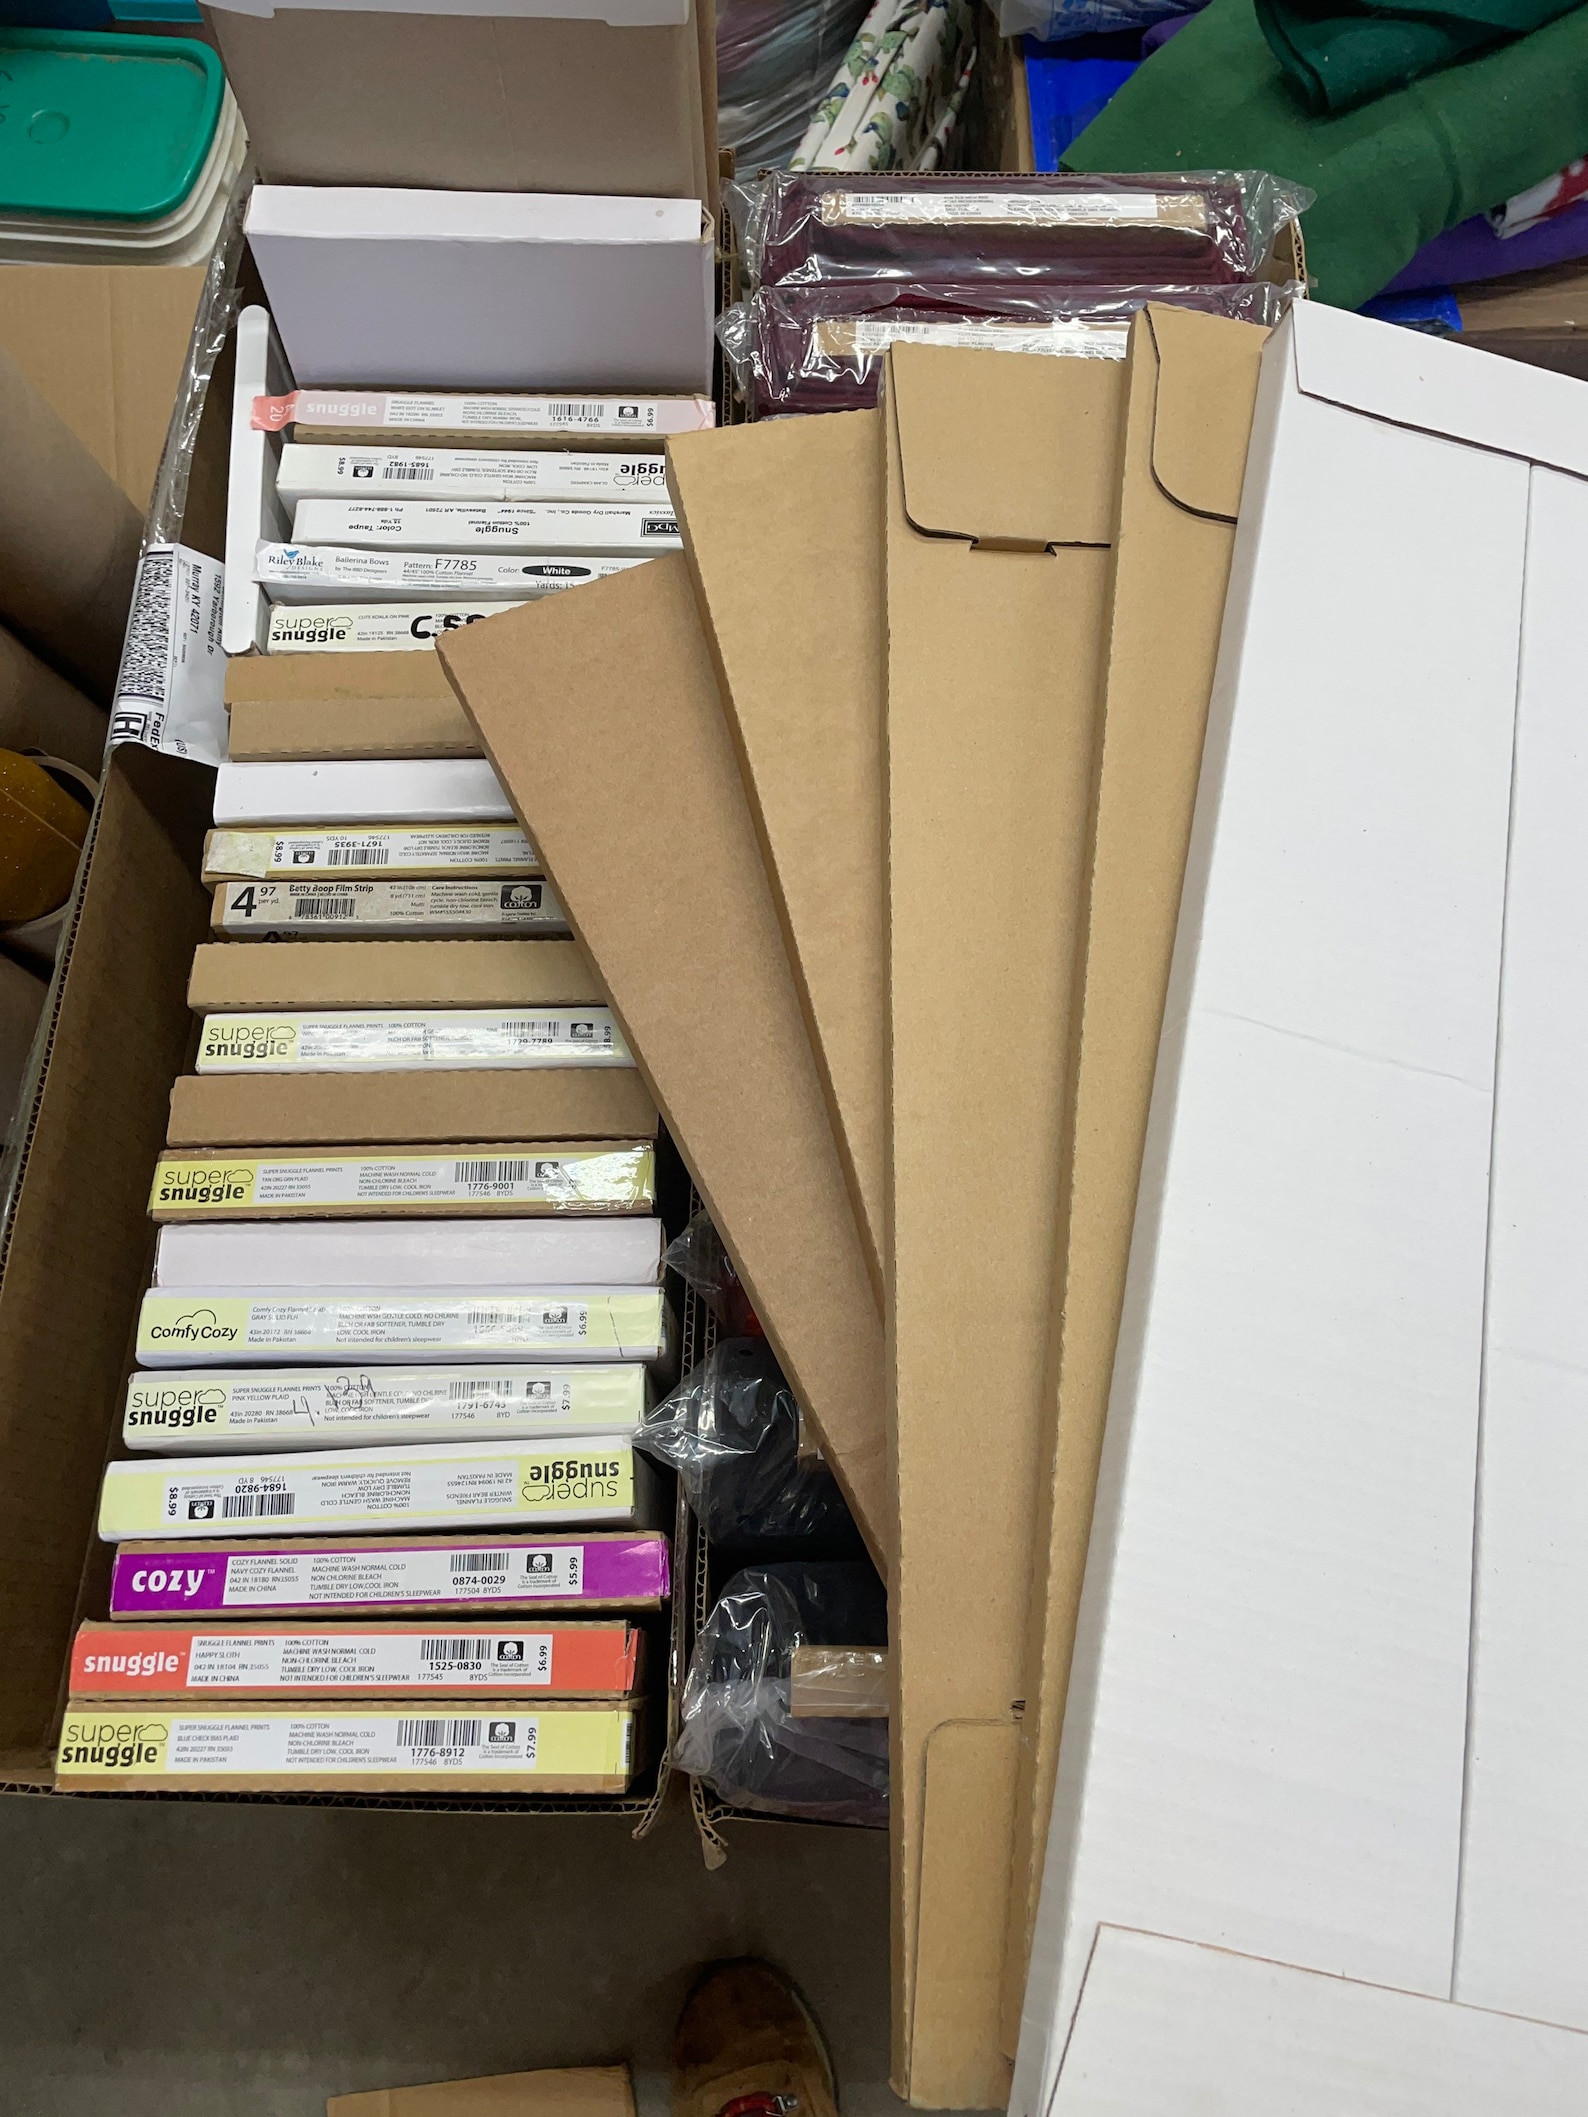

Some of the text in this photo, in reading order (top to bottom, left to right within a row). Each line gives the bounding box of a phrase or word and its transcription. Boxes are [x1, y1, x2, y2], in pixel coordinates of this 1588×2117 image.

[306, 402, 377, 417] snuggle
[646, 407, 654, 427] $6.99
[634, 473, 665, 486] per
[348, 523, 402, 532] Color: Taupe
[475, 526, 519, 535] Snuggle
[268, 555, 324, 570] Riley Blake
[335, 556, 389, 566] Ballerina Bows
[403, 558, 477, 571] Pattern: F7785
[498, 566, 571, 576] Color: White
[213, 574, 222, 594] 1592
[190, 563, 202, 634] Murray KY 42071
[208, 596, 220, 644] Yarborough
[275, 616, 333, 630] super
[272, 628, 346, 643] snuggle
[206, 646, 215, 656] Dr
[149, 711, 165, 750] FedEx
[274, 841, 284, 862] $8.99
[334, 840, 382, 848] 1671-3935
[289, 884, 311, 893] Betty
[335, 884, 352, 892] Film
[354, 885, 374, 894] Strip
[231, 886, 276, 917] 4 97
[209, 1026, 275, 1043] super
[205, 1040, 288, 1058] snuggle
[163, 1170, 232, 1188] super
[467, 1182, 514, 1191] 1776-9001
[160, 1184, 245, 1203] snuggle
[578, 1311, 588, 1335] $6.99
[132, 1389, 202, 1410] super
[561, 1383, 571, 1411] $7.99
[128, 1406, 217, 1428] snuggle
[530, 1460, 620, 1484] snuggle
[235, 1482, 287, 1494] 1684-9820
[545, 1478, 618, 1500] super
[168, 1487, 179, 1516] $8.99
[232, 1558, 249, 1566] COZY
[279, 1557, 298, 1565] SOLID
[568, 1557, 578, 1586] $5.99
[131, 1569, 206, 1597] cozy
[452, 1575, 506, 1586] 0874-0029
[323, 1592, 355, 1600] INTENDED
[369, 1590, 405, 1598] CHILDREN'S
[405, 1589, 442, 1597] SLEEPWEAR
[454, 1586, 501, 1595] 177504 8YDS
[84, 1651, 179, 1676] snuggle
[195, 1651, 241, 1659] HAPPY SLOTH
[537, 1645, 548, 1672] $6.99
[429, 1662, 482, 1671] 1525-0830
[417, 1673, 488, 1681] 177545 8YDS
[66, 1724, 144, 1747] super
[525, 1727, 537, 1759] $7.99
[62, 1743, 158, 1767] snuggle
[411, 1747, 465, 1757] 1776-8912
[411, 1758, 437, 1766] 177546
